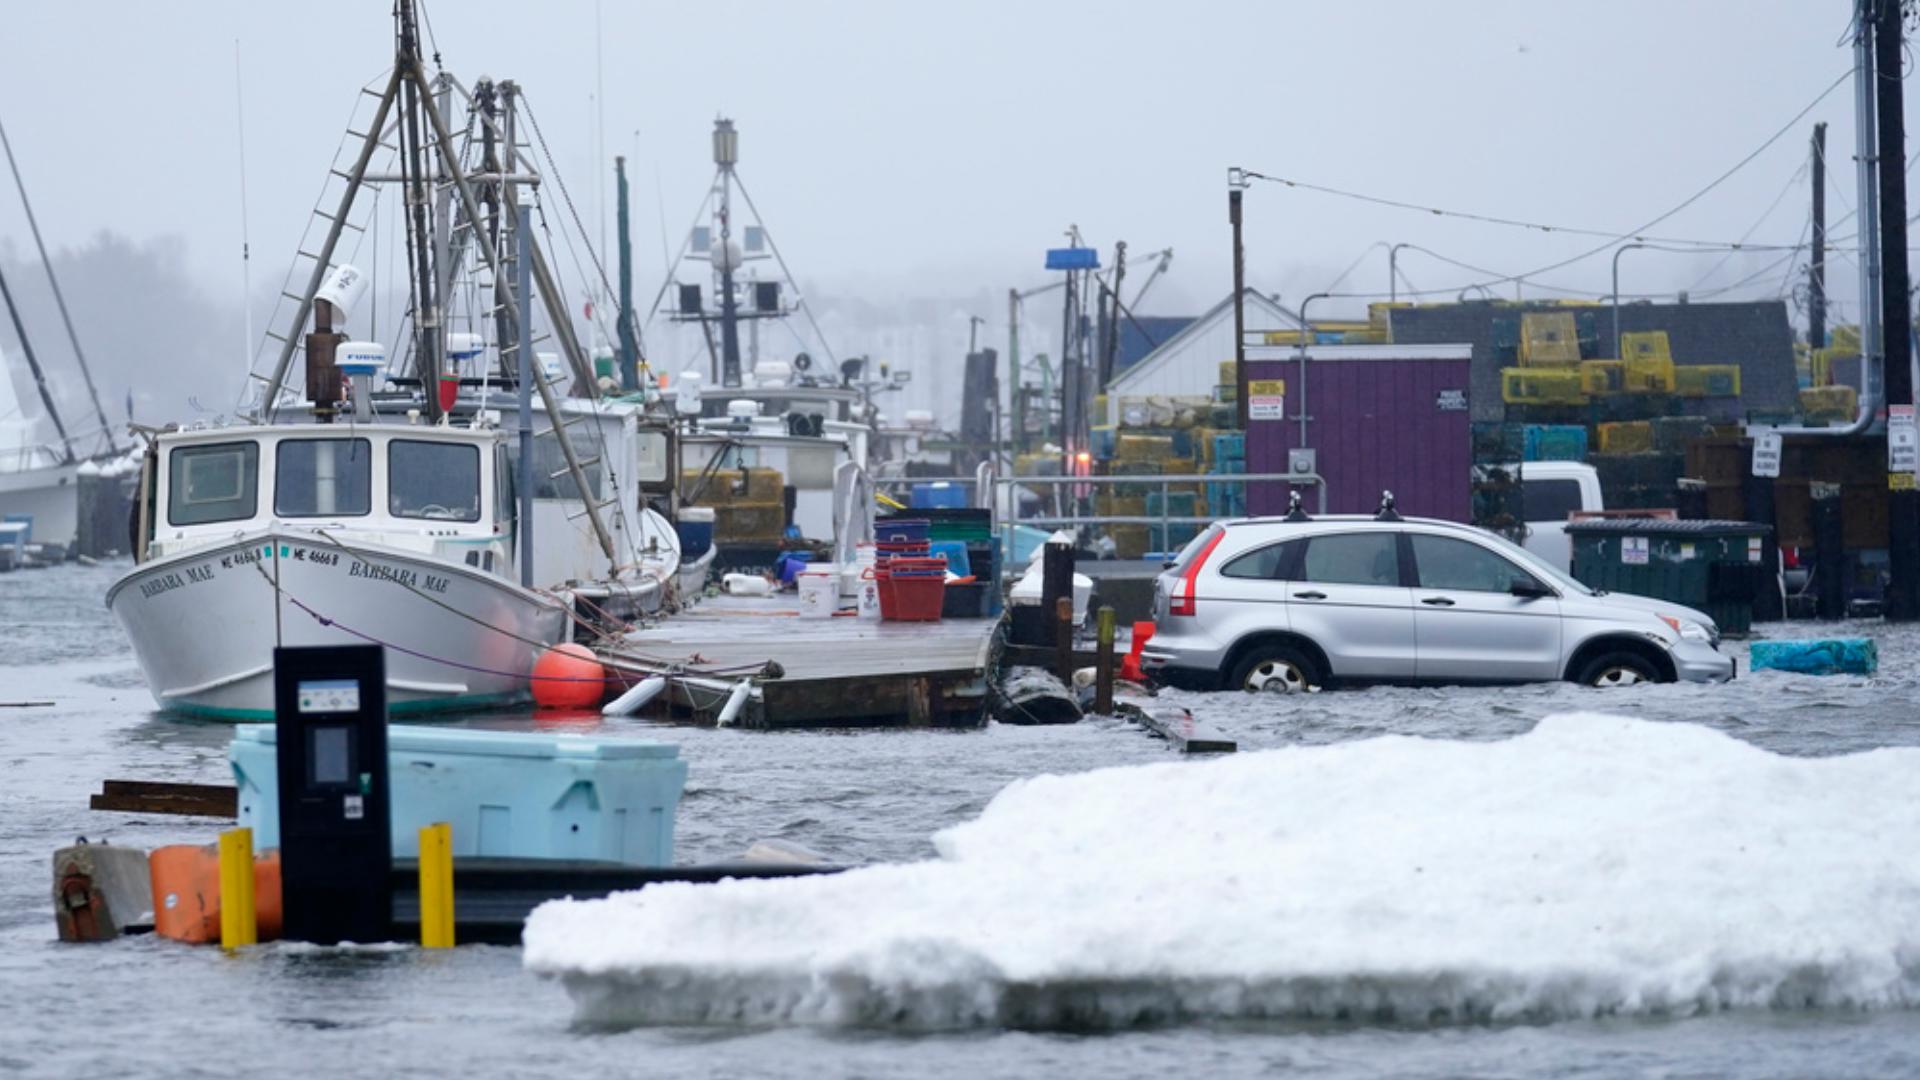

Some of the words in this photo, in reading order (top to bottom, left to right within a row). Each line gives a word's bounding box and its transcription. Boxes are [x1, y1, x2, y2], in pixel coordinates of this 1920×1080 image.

[294, 548, 305, 561] ME
[140, 573, 185, 599] BARBARA
[186, 564, 215, 584] MAE
[349, 561, 417, 587] BARBARA
[422, 575, 450, 593] MAE
